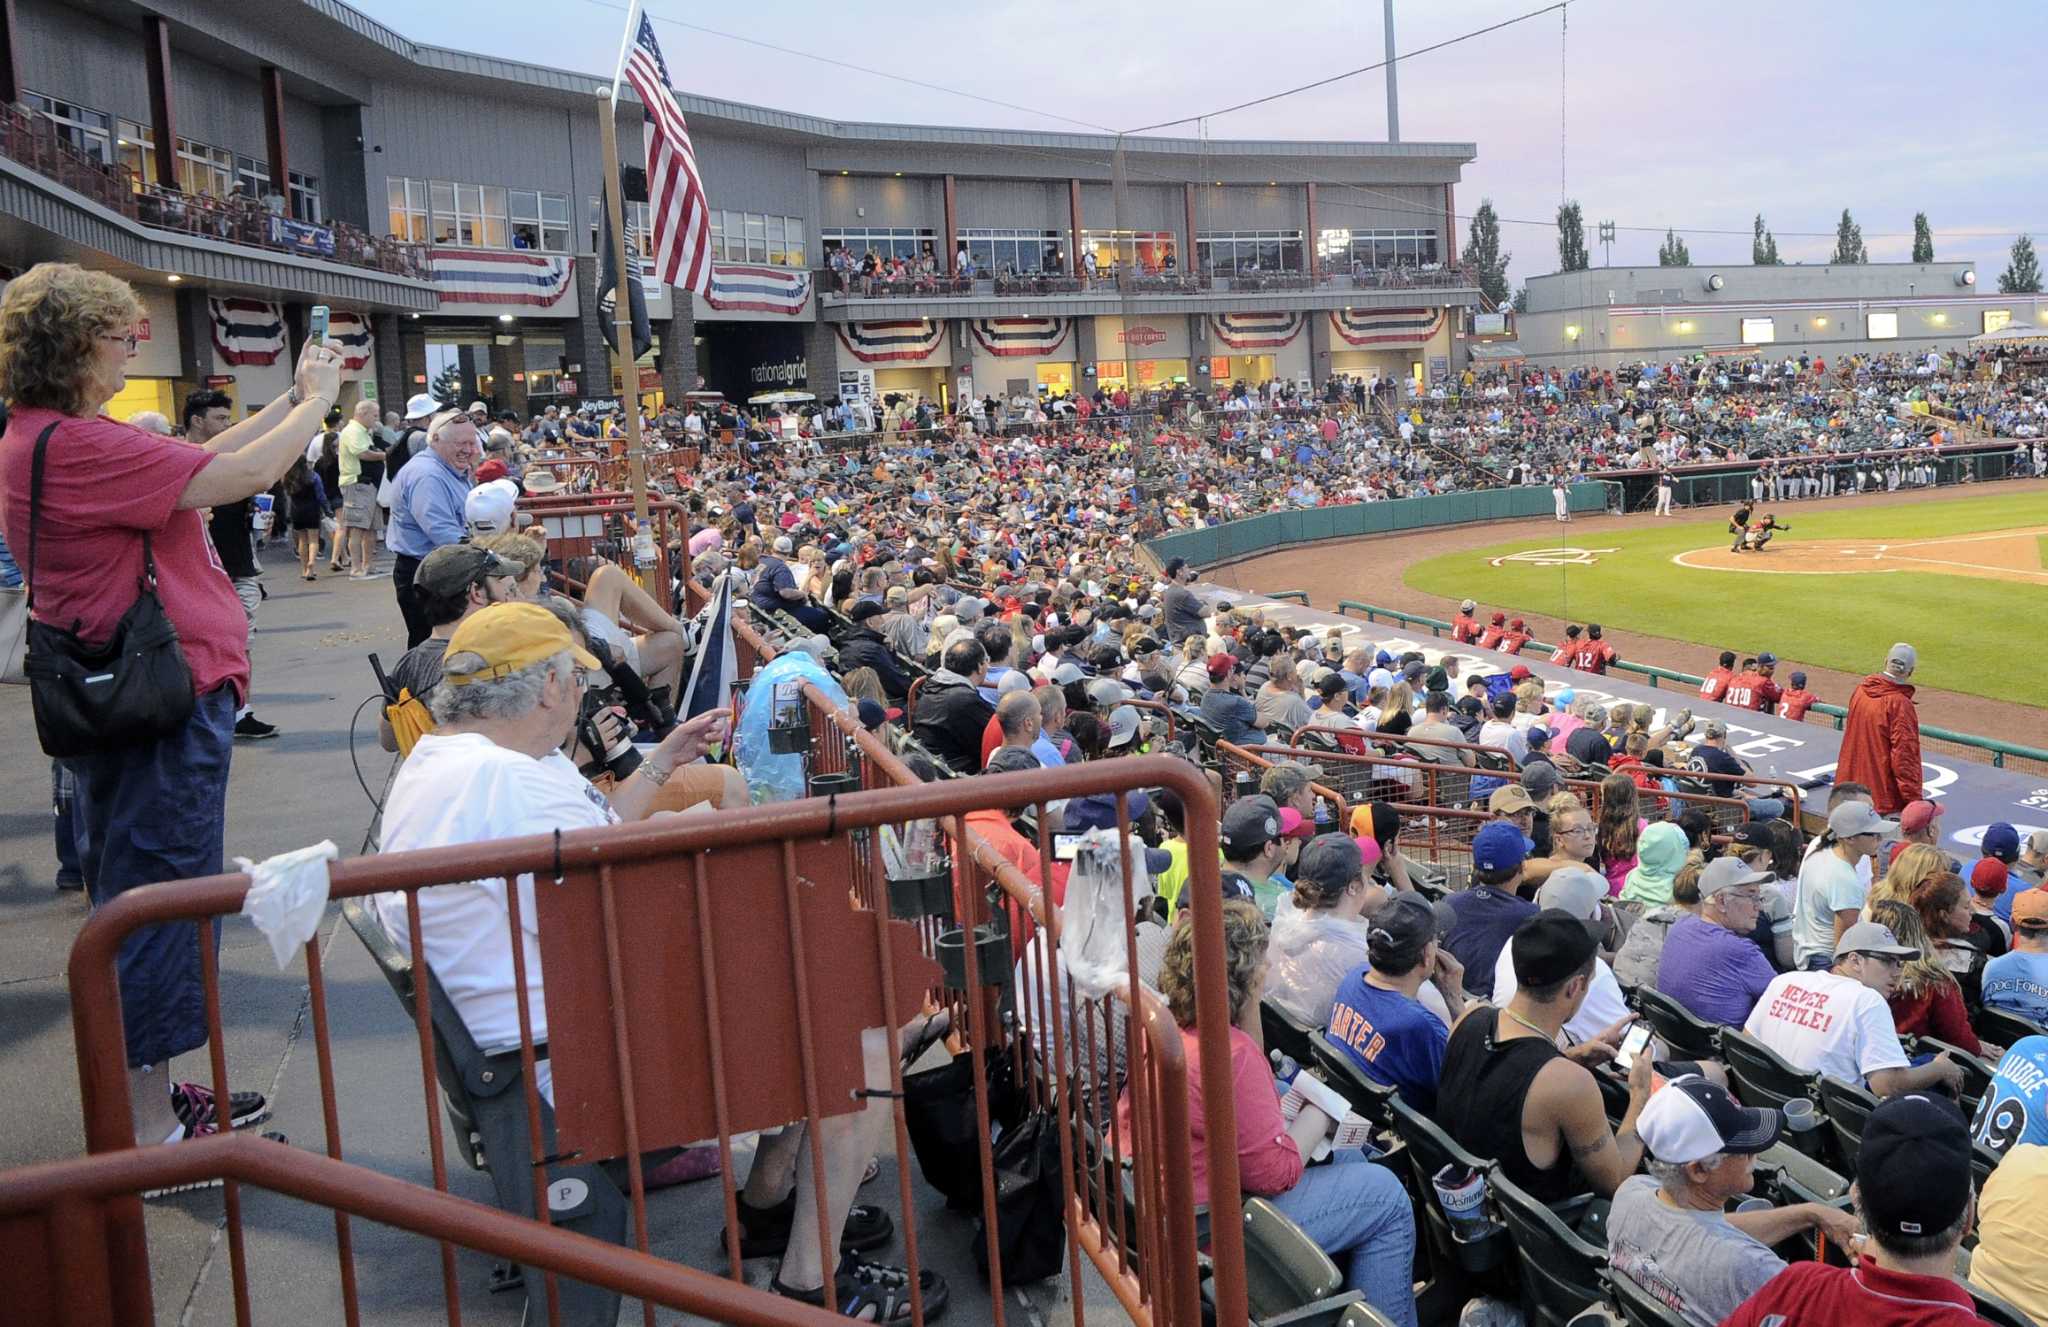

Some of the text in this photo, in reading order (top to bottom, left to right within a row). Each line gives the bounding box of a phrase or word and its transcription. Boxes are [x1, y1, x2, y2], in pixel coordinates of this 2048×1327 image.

[751, 356, 807, 386] nationalgrid
[581, 399, 620, 412] KeyBank
[1578, 652, 1593, 668] 12
[1780, 702, 1790, 719] 2
[1780, 984, 1829, 1010] NEVER
[1769, 1000, 1833, 1033] SETTLE!
[1997, 1054, 2048, 1099] JUDGE
[1446, 1186, 1483, 1209] Desmond
